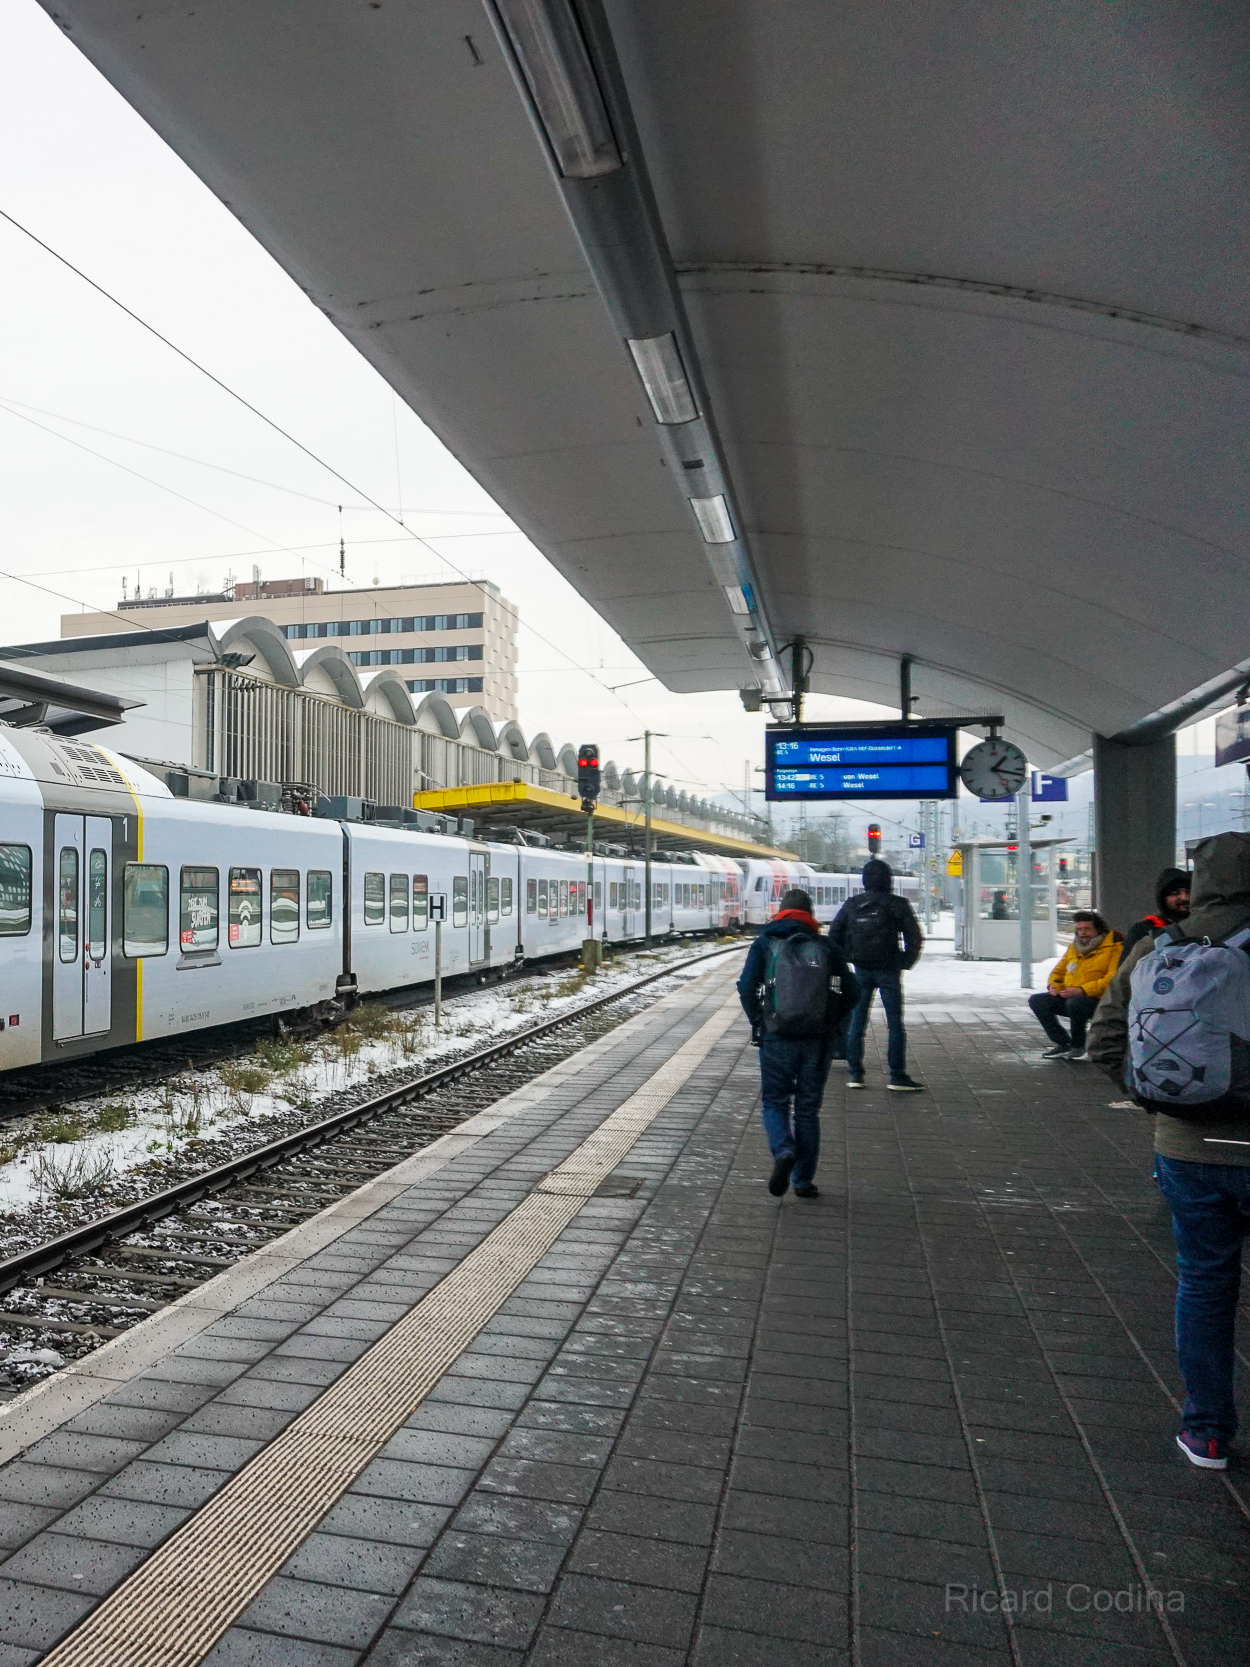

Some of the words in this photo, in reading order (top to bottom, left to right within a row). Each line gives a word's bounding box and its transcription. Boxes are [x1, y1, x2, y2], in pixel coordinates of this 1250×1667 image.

[777, 742, 799, 750] 13:16
[810, 753, 841, 762] Wesel
[1036, 771, 1052, 794] F
[122, 817, 128, 843] 1
[910, 834, 921, 846] G
[430, 896, 444, 919] H
